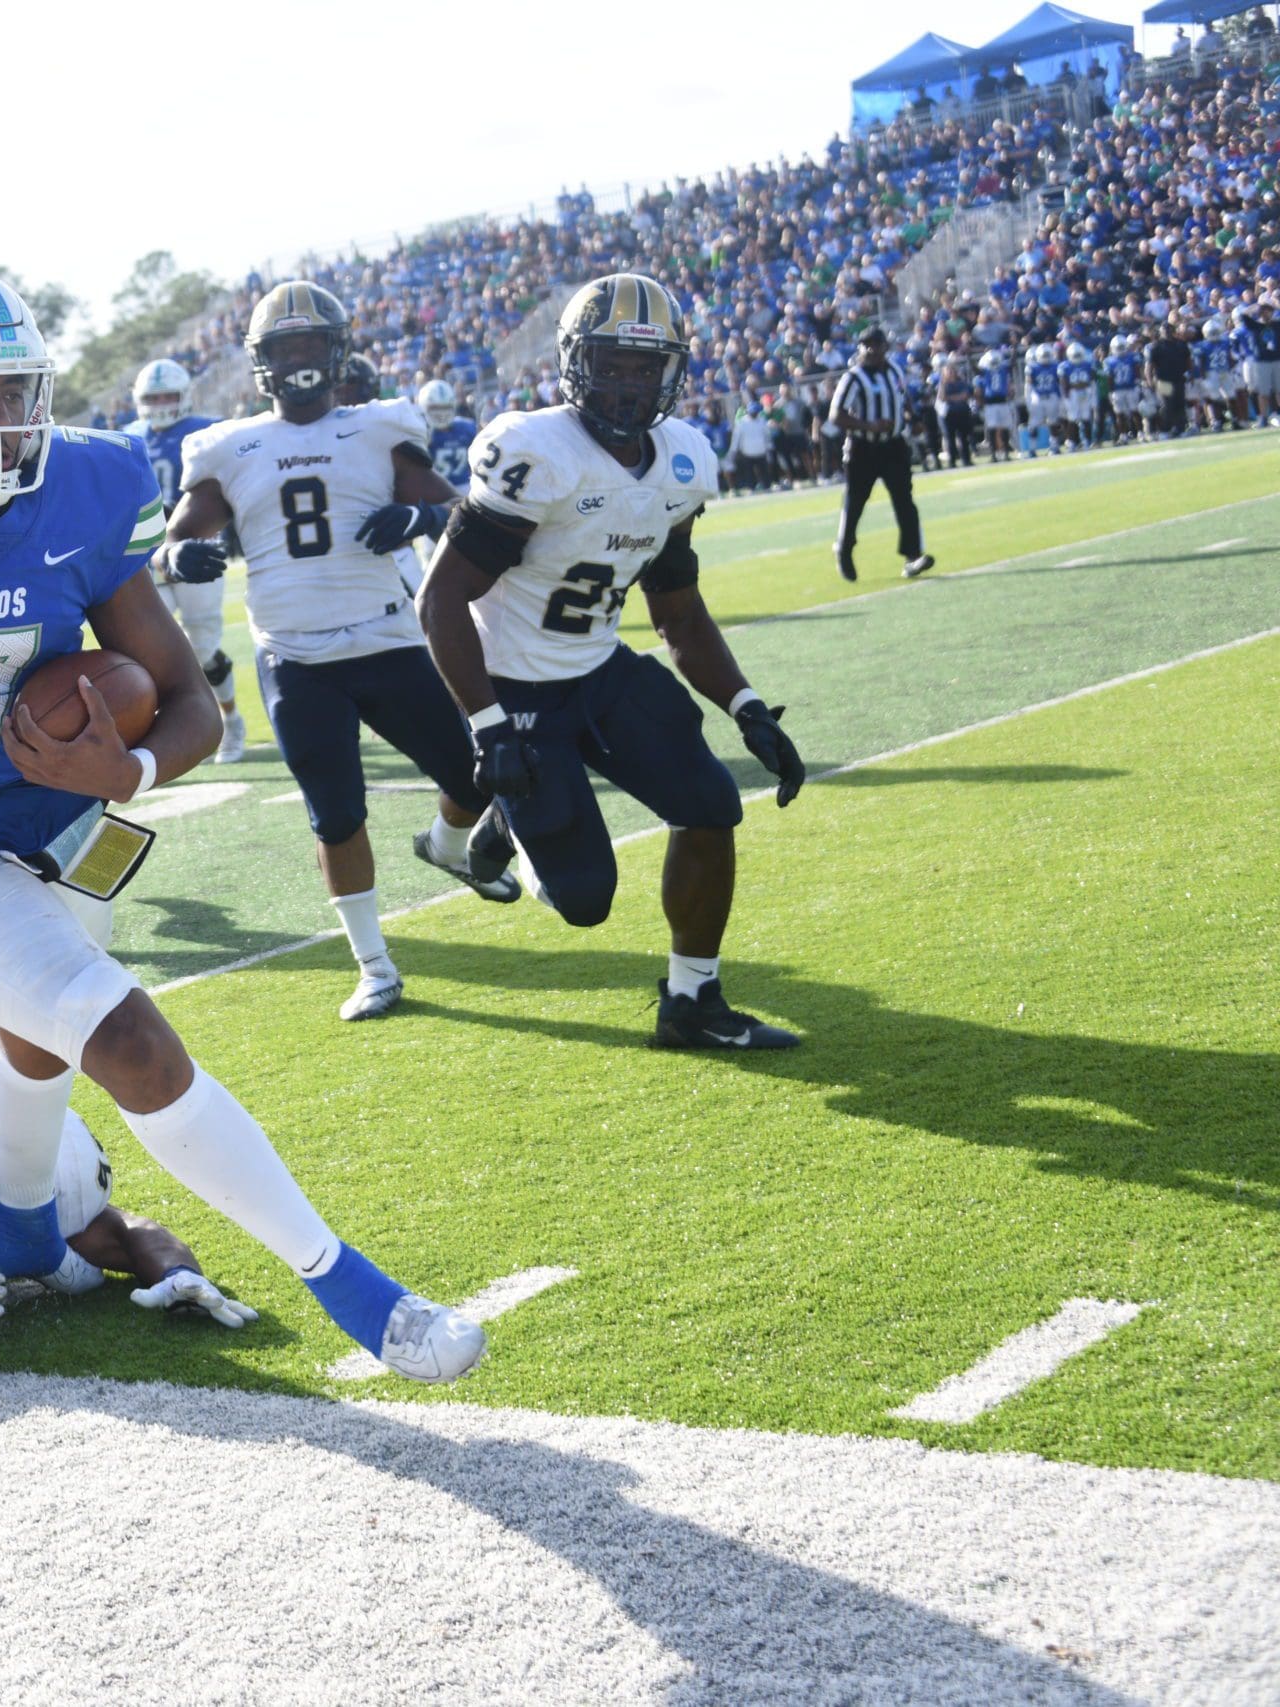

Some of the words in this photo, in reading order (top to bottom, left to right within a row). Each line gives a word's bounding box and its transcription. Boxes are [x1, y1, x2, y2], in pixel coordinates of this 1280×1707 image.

[276, 455, 332, 471] Wingate
[435, 446, 467, 476] 57
[473, 441, 532, 501] 24
[581, 496, 605, 510] SAC
[279, 475, 332, 559] 8
[606, 533, 656, 552] Wingate
[510, 711, 538, 730] W
